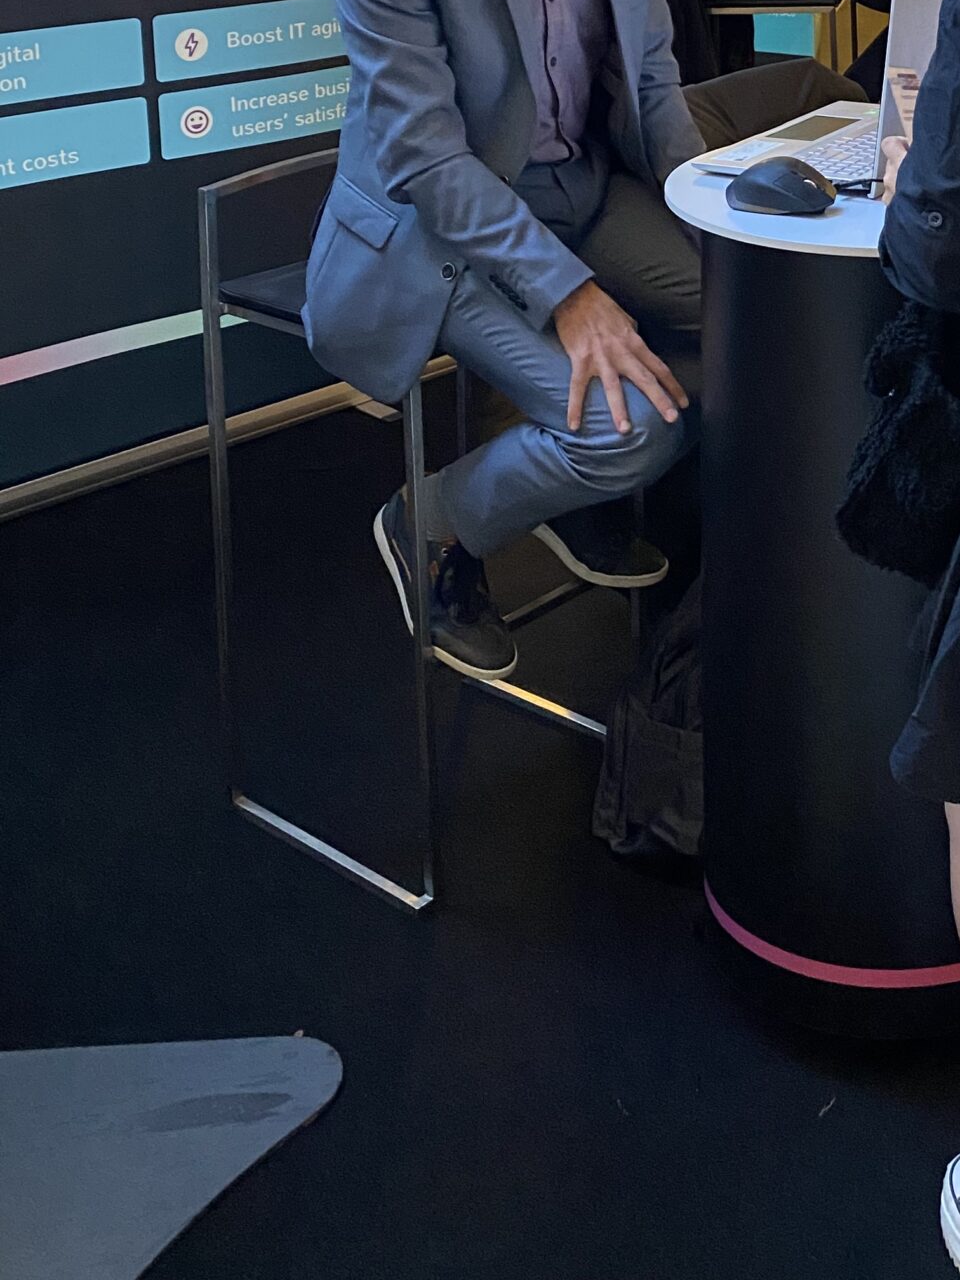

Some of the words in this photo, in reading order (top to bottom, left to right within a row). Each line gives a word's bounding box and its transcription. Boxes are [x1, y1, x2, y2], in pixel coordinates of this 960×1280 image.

[226, 25, 283, 49] Boost
[289, 22, 305, 40] IT
[230, 85, 309, 113] Increase
[22, 148, 80, 173] costs
